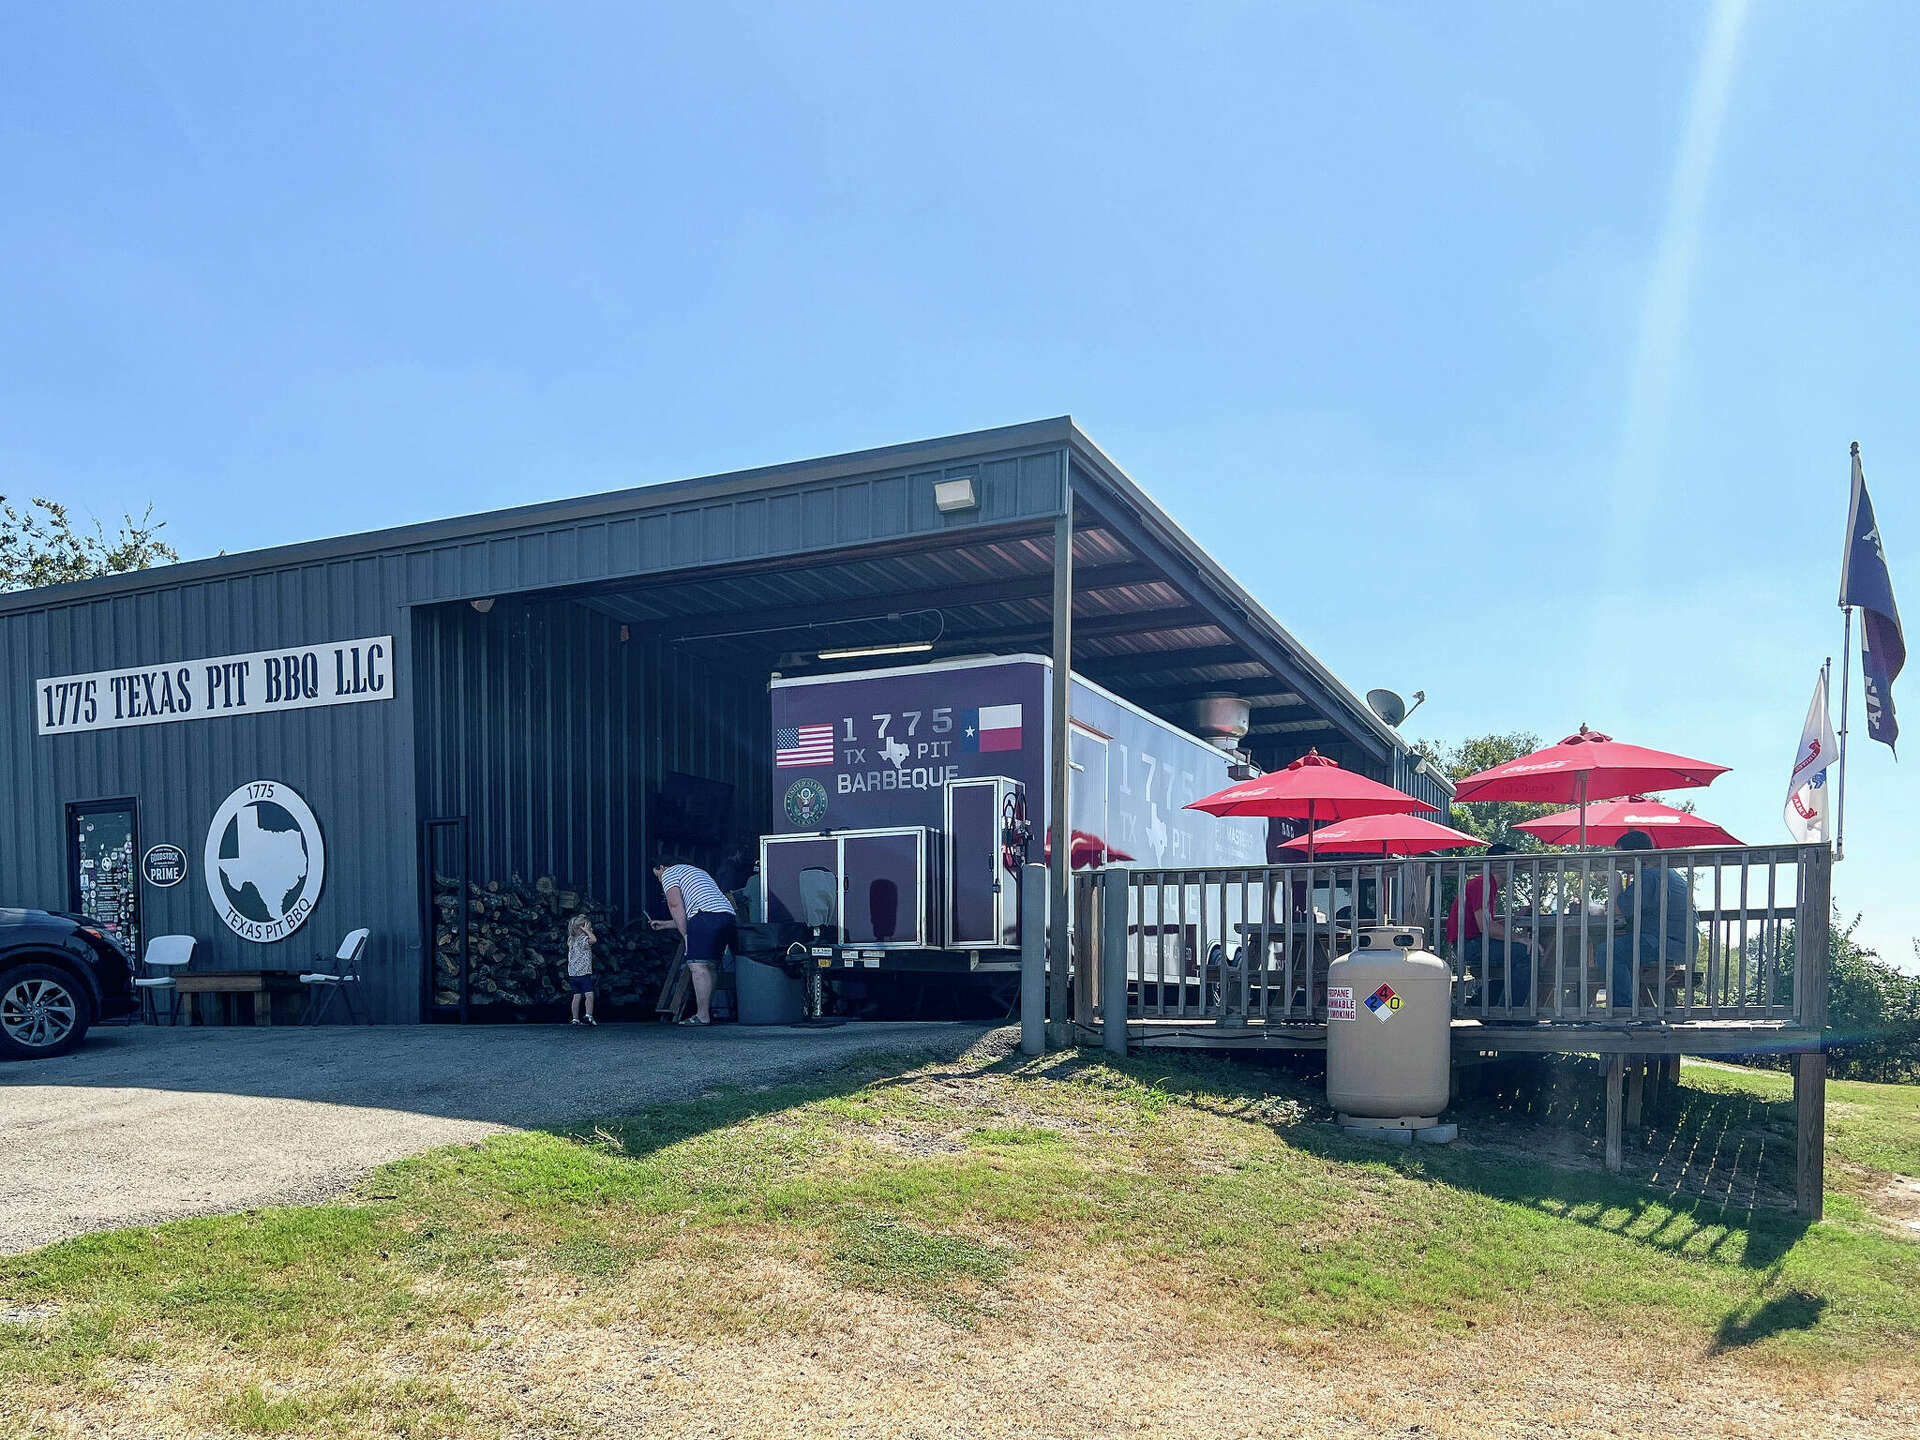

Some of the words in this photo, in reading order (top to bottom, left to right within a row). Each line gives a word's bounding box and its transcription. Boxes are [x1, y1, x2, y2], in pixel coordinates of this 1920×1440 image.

[43, 680, 97, 727] 1775
[110, 667, 191, 720] TEXAS
[206, 661, 249, 710] PIT
[264, 652, 319, 704] BBQ
[335, 643, 384, 696] LLC
[842, 707, 953, 742] 1775
[843, 748, 866, 765] TX
[917, 740, 952, 759] PIT
[246, 783, 275, 800] 1775
[837, 765, 959, 794] BARBEQUE
[1172, 826, 1193, 863] PIT
[150, 867, 180, 881] PRIME
[224, 906, 262, 939] TEXAS
[266, 920, 284, 939] PIT
[286, 897, 312, 929] BBQ
[1370, 995, 1378, 1009] 2
[1380, 986, 1388, 999] 4
[1390, 997, 1400, 1010] 0
